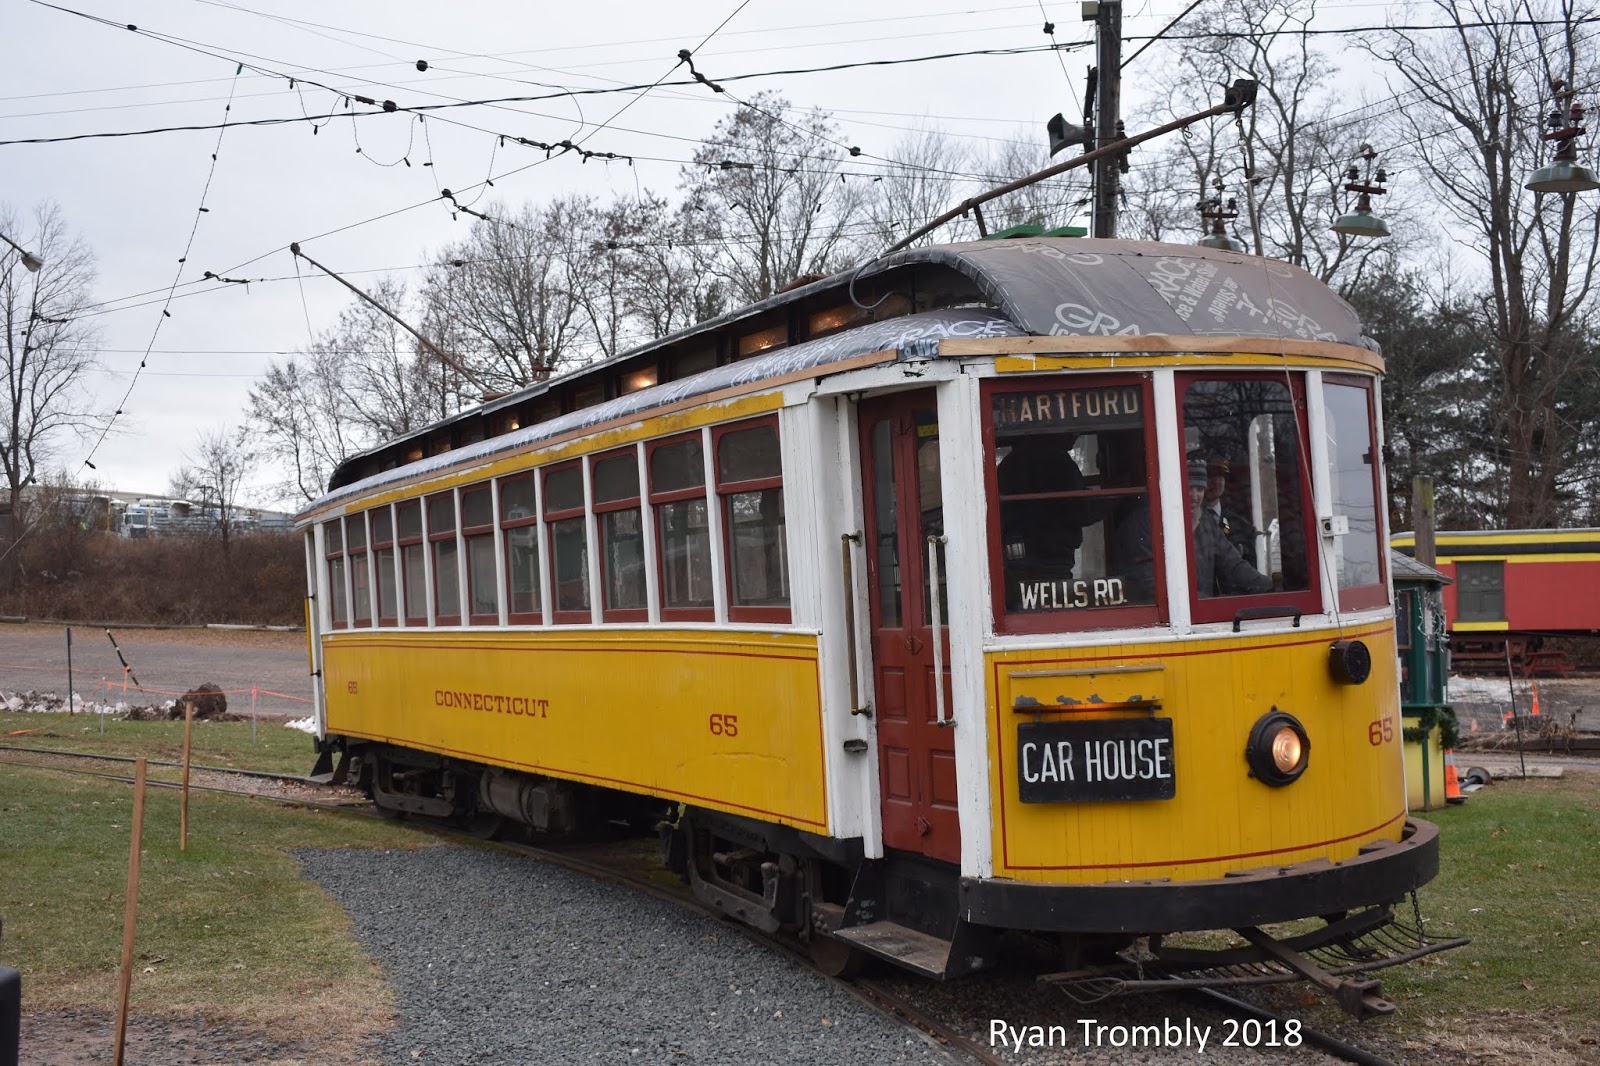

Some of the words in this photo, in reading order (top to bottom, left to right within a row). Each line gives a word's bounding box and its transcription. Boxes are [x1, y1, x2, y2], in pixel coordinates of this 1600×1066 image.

[1147, 257, 1197, 305] RACE
[1001, 387, 1139, 423] HARTFORD
[1020, 580, 1088, 610] WELLS
[347, 680, 358, 695] 65
[435, 690, 549, 718] CONNECTICUT
[710, 713, 738, 737] 65
[1368, 716, 1393, 747] 65
[1022, 741, 1075, 783] CAR
[1085, 738, 1171, 782] HOUSE
